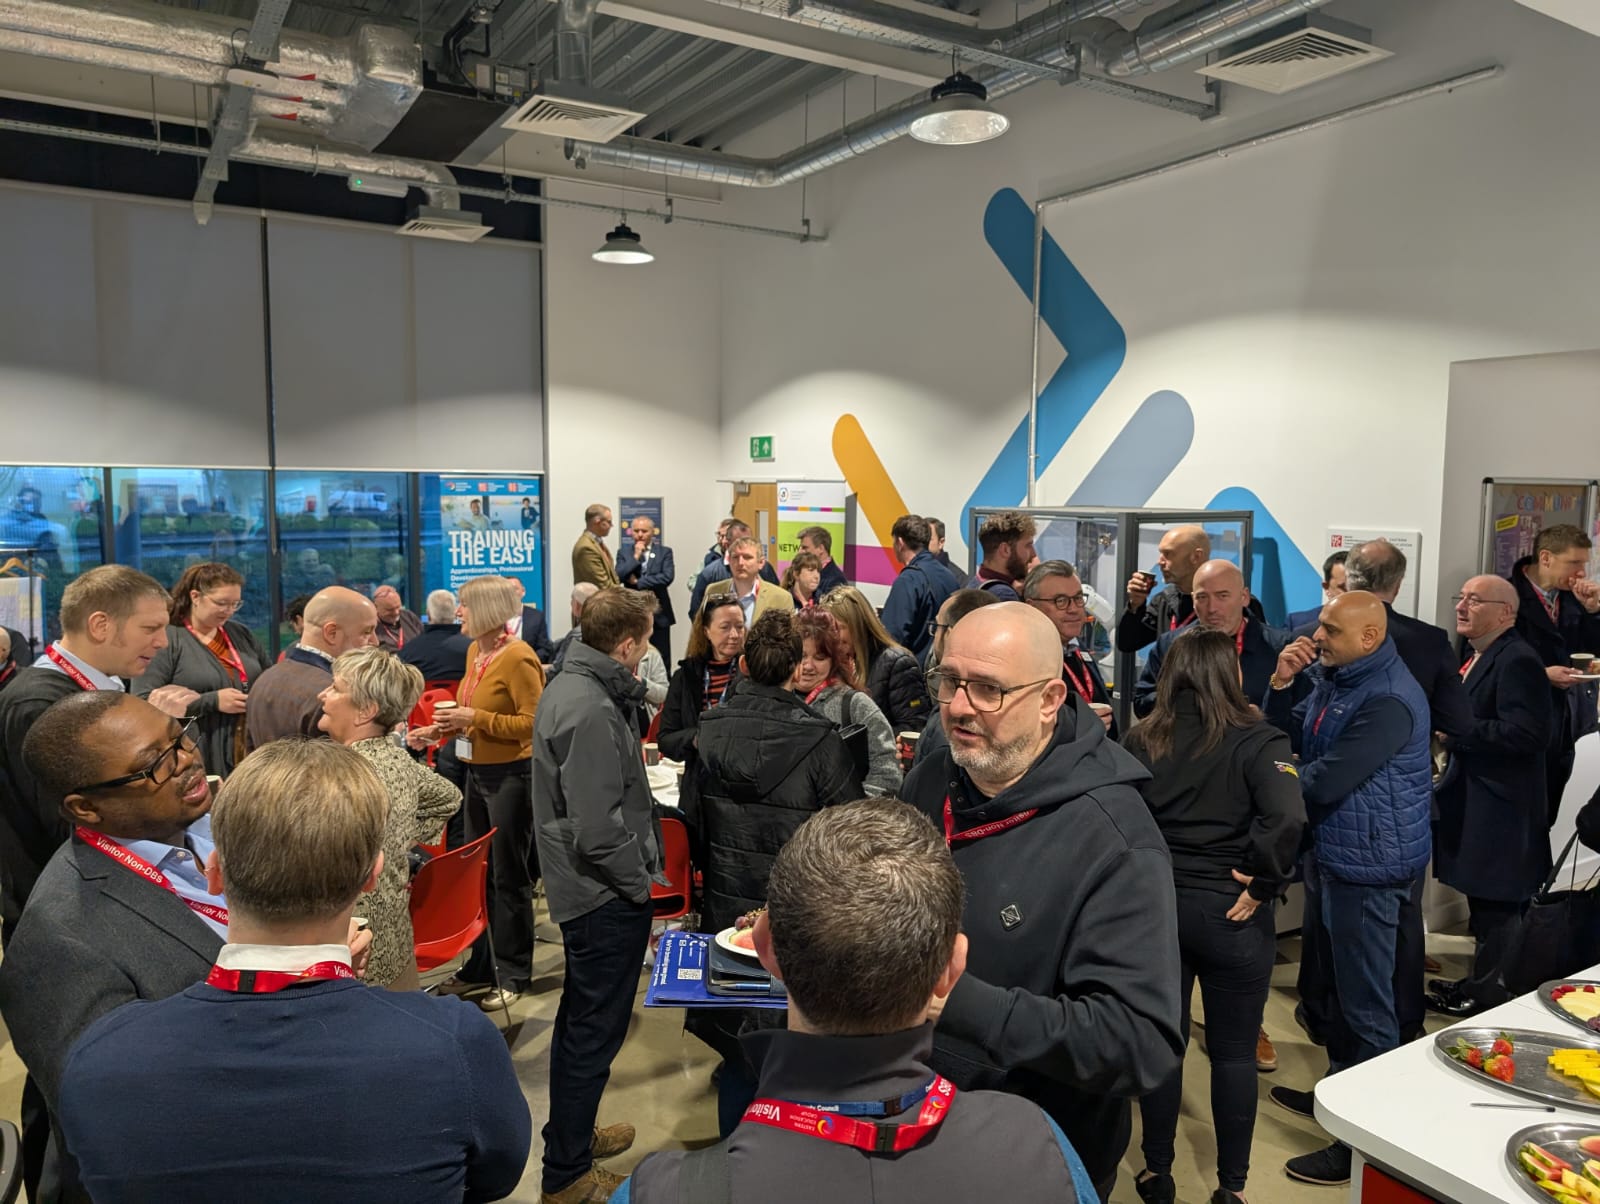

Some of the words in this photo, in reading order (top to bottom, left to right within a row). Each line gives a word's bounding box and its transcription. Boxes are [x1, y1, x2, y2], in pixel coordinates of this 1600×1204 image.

[448, 529, 535, 549] TRAINING
[778, 543, 801, 553] NETW
[448, 547, 485, 566] THE
[489, 546, 535, 564] EAST
[96, 836, 126, 862] Visitor
